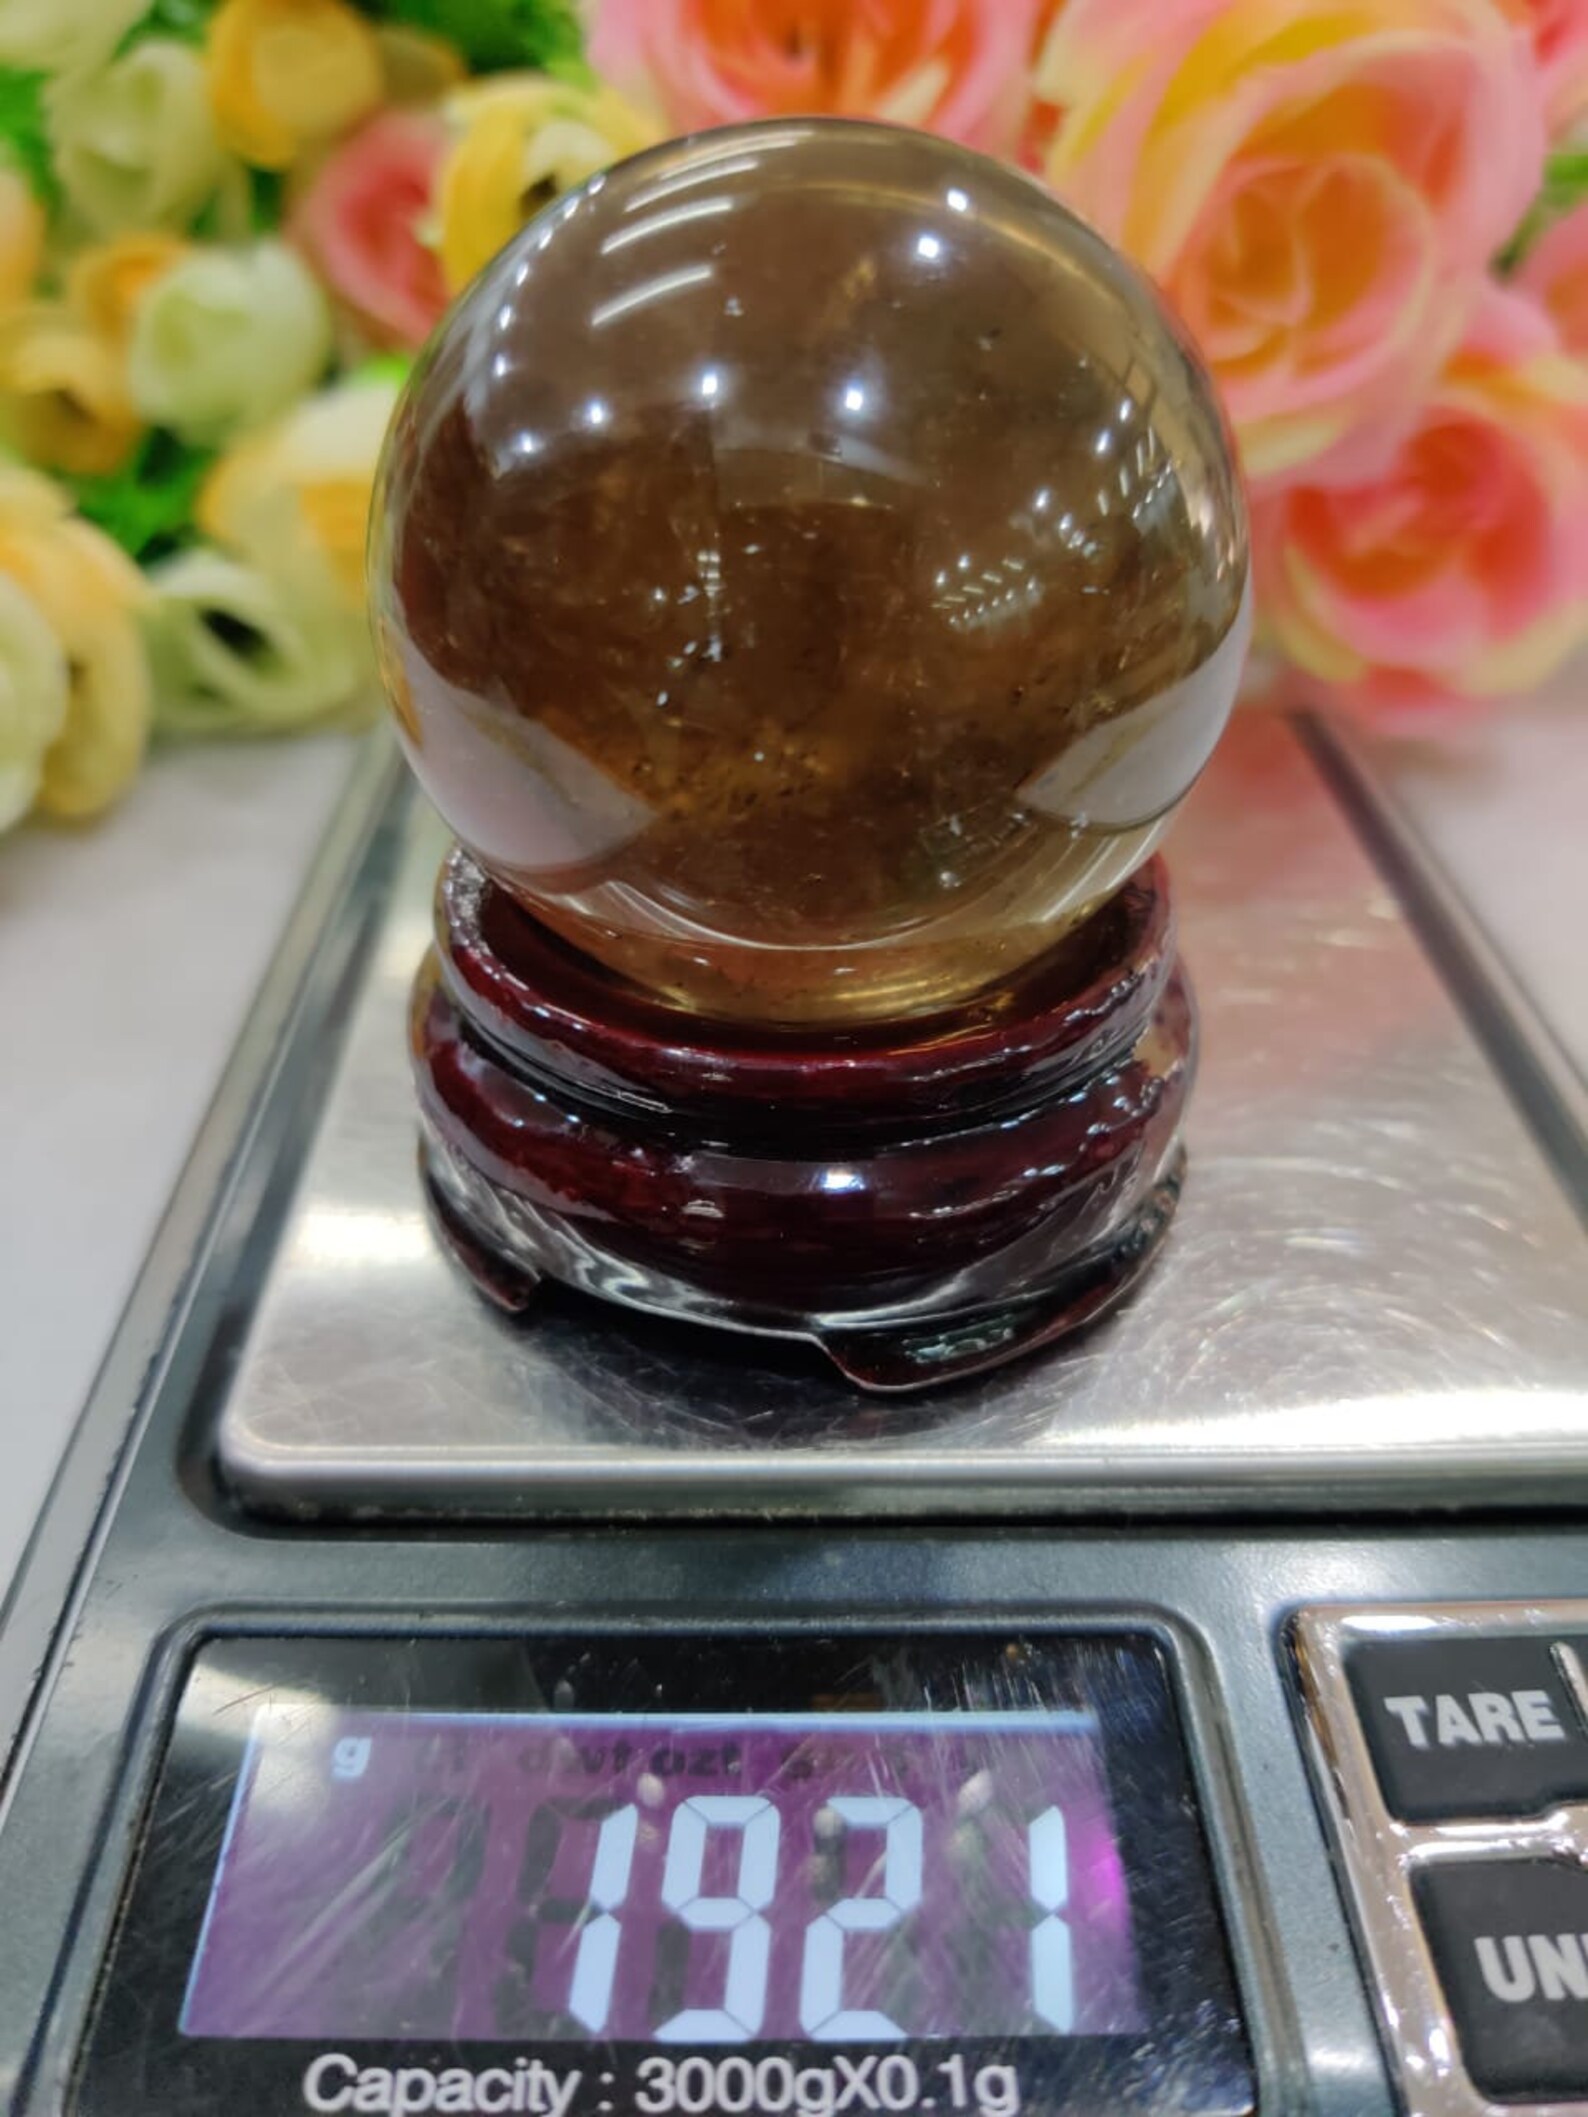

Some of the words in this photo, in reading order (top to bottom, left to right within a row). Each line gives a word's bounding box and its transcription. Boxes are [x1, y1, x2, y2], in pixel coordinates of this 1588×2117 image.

[1384, 1690, 1566, 1750] TARE
[331, 1736, 372, 1780] g
[1475, 1933, 1588, 2002] UN
[303, 2052, 583, 2117] Capacity
[634, 2053, 1020, 2117] 3000gX0.1g
